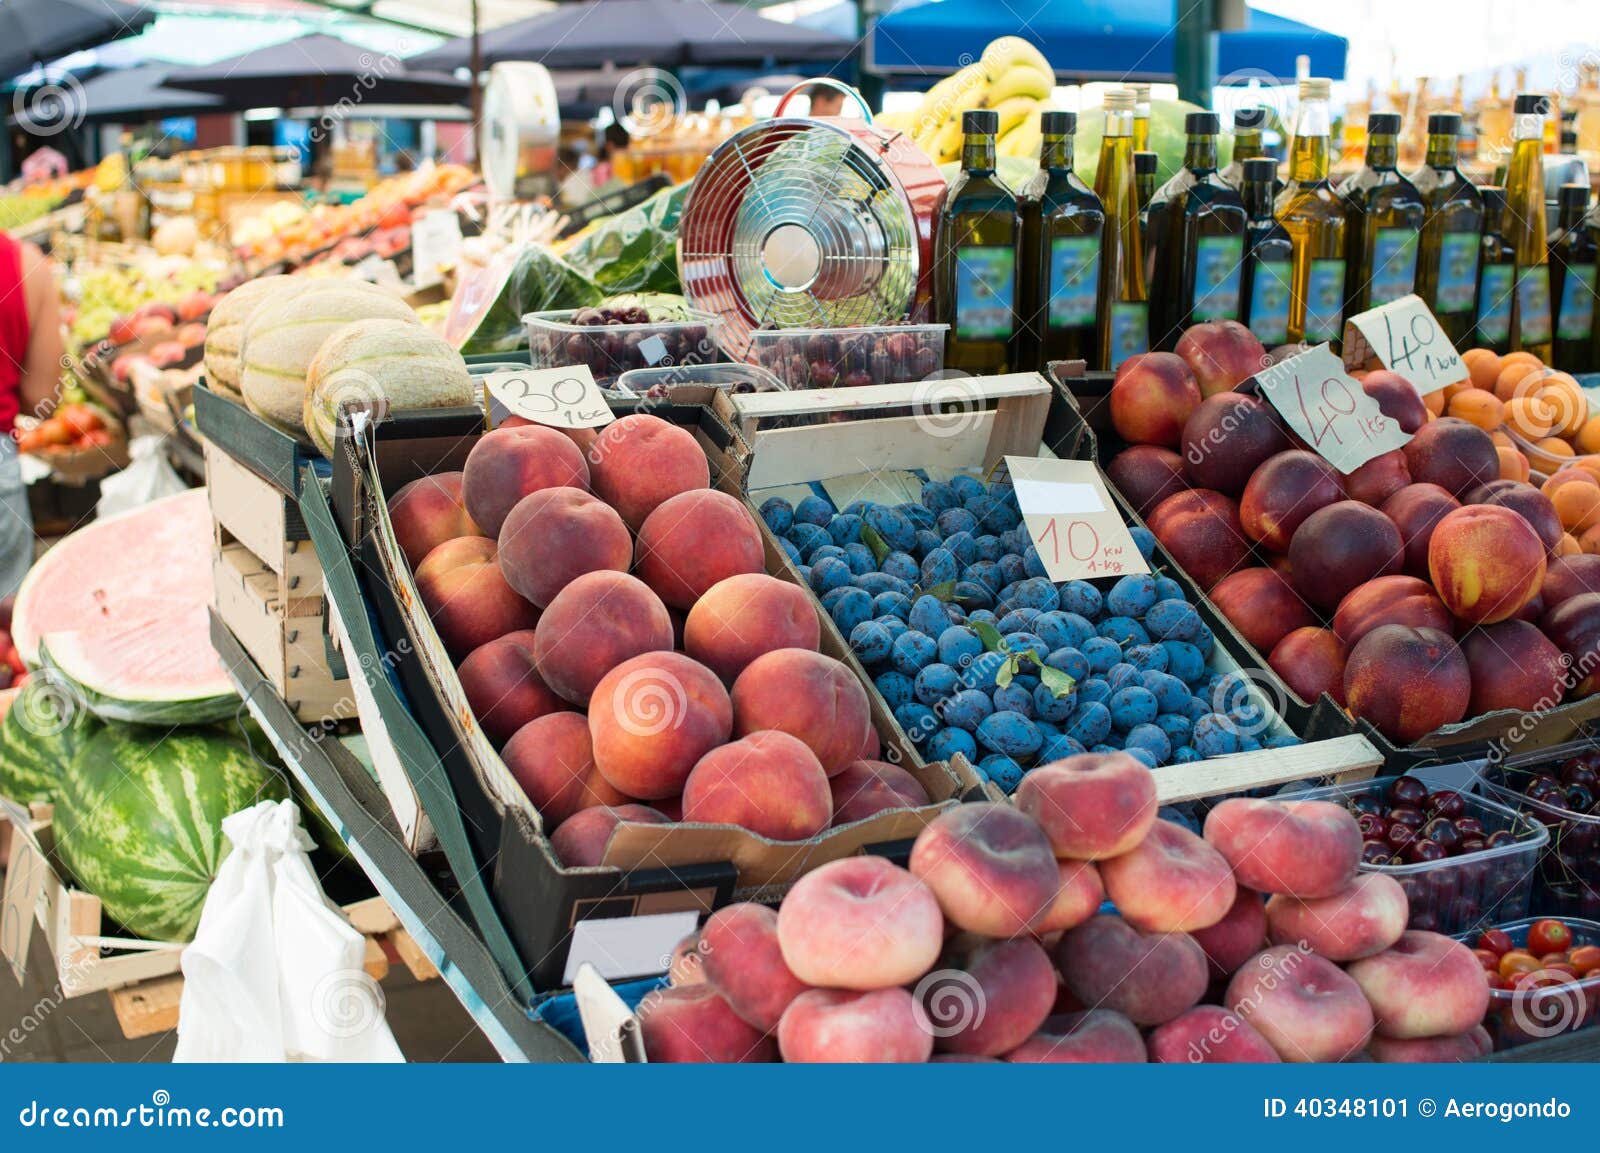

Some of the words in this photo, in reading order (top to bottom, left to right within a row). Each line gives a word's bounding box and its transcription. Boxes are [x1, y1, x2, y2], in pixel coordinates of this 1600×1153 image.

[1383, 312, 1434, 370] 40
[501, 378, 586, 412] 30
[1294, 375, 1355, 447] 40
[1038, 517, 1099, 564] 10
